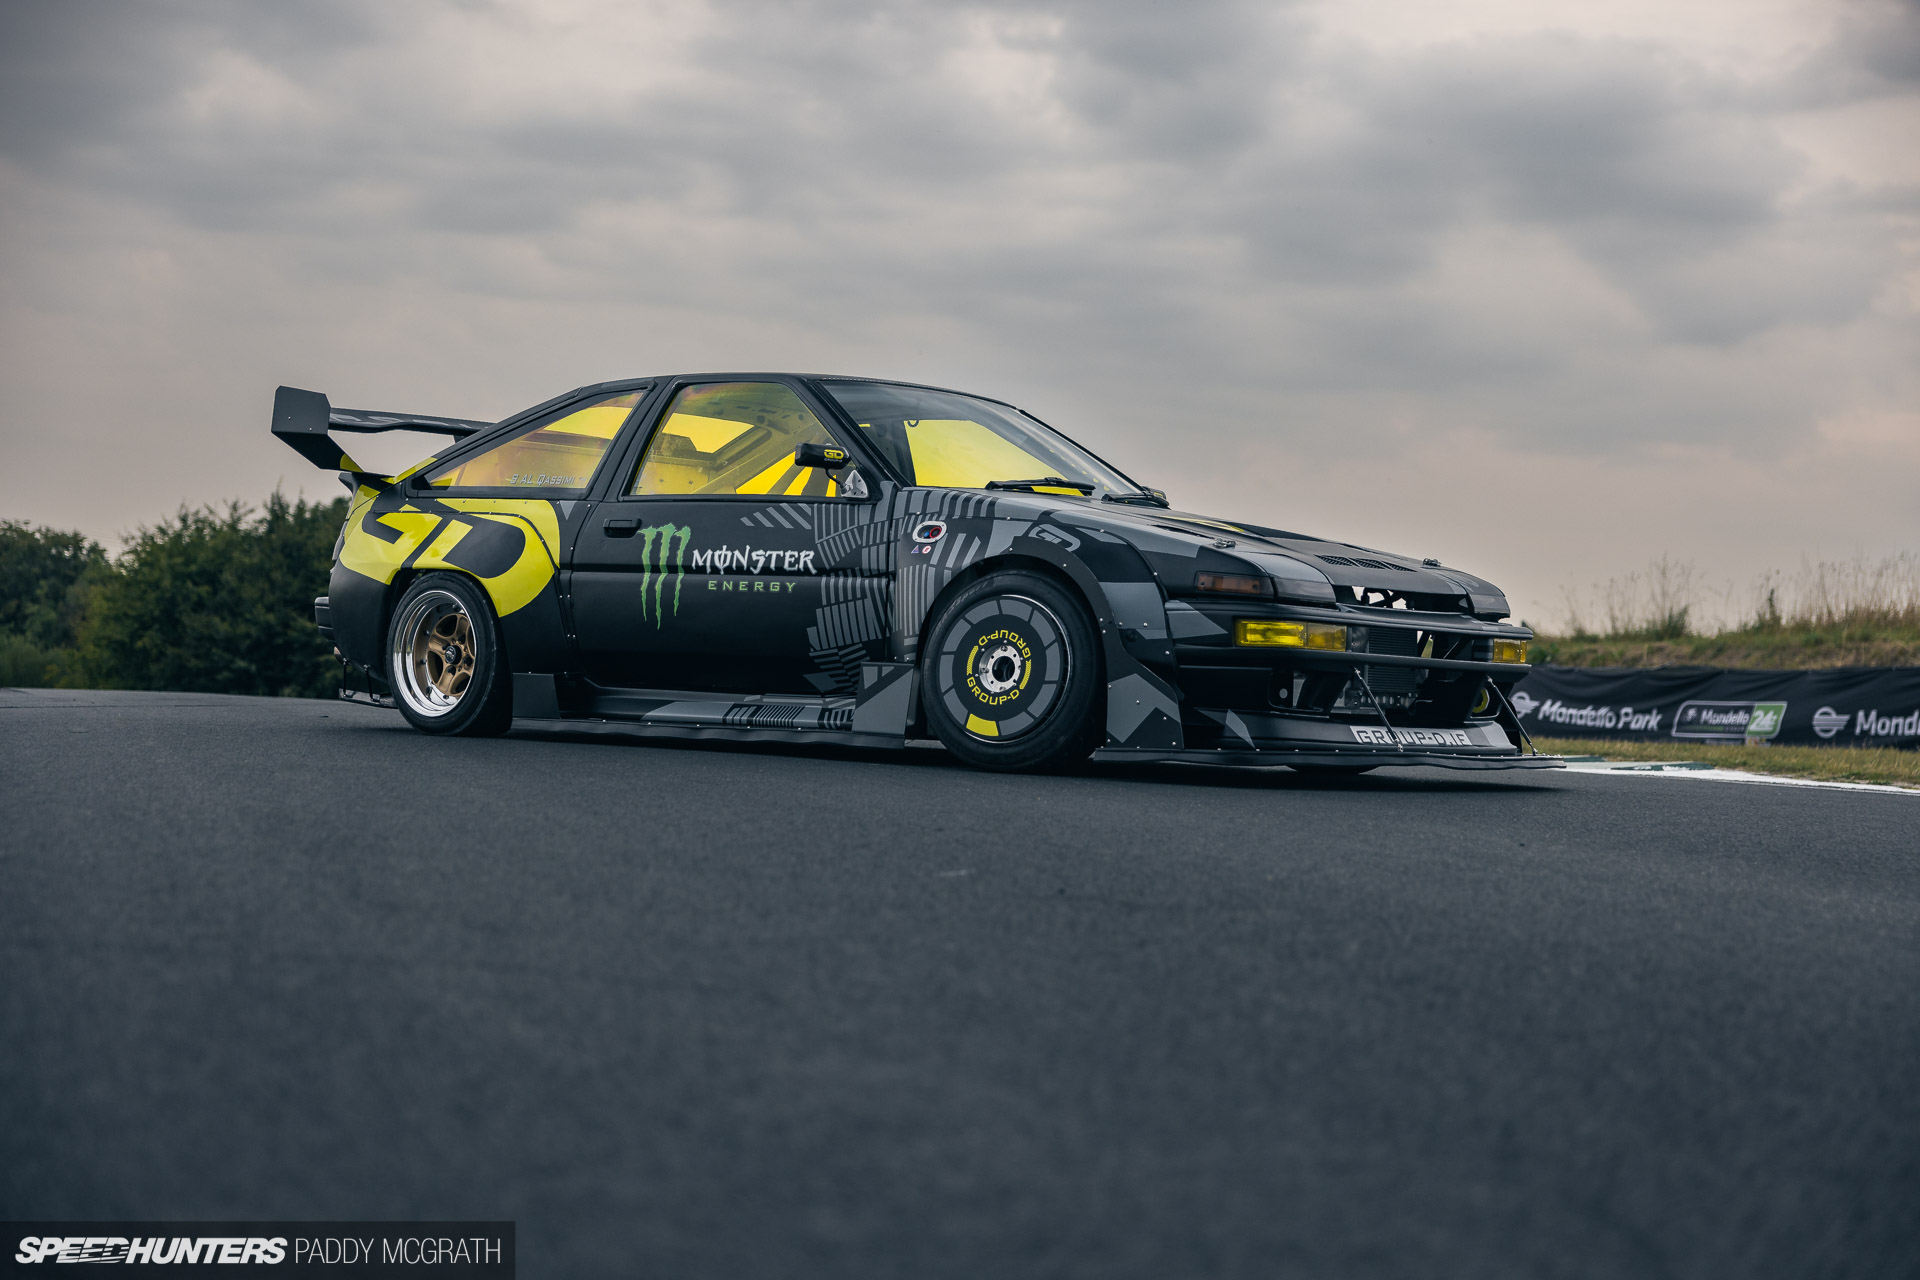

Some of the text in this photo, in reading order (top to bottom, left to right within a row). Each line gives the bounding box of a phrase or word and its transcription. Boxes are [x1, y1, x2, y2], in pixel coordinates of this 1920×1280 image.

[520, 474, 533, 484] AL
[537, 474, 576, 486] QASSIMI
[708, 581, 796, 593] ENERGY
[978, 630, 1032, 659] GROUP-D
[966, 676, 1020, 706] GROUP-D
[1537, 699, 1663, 731] Mondello Park
[1701, 709, 1750, 726] Mondello
[1854, 709, 1920, 736] Mond
